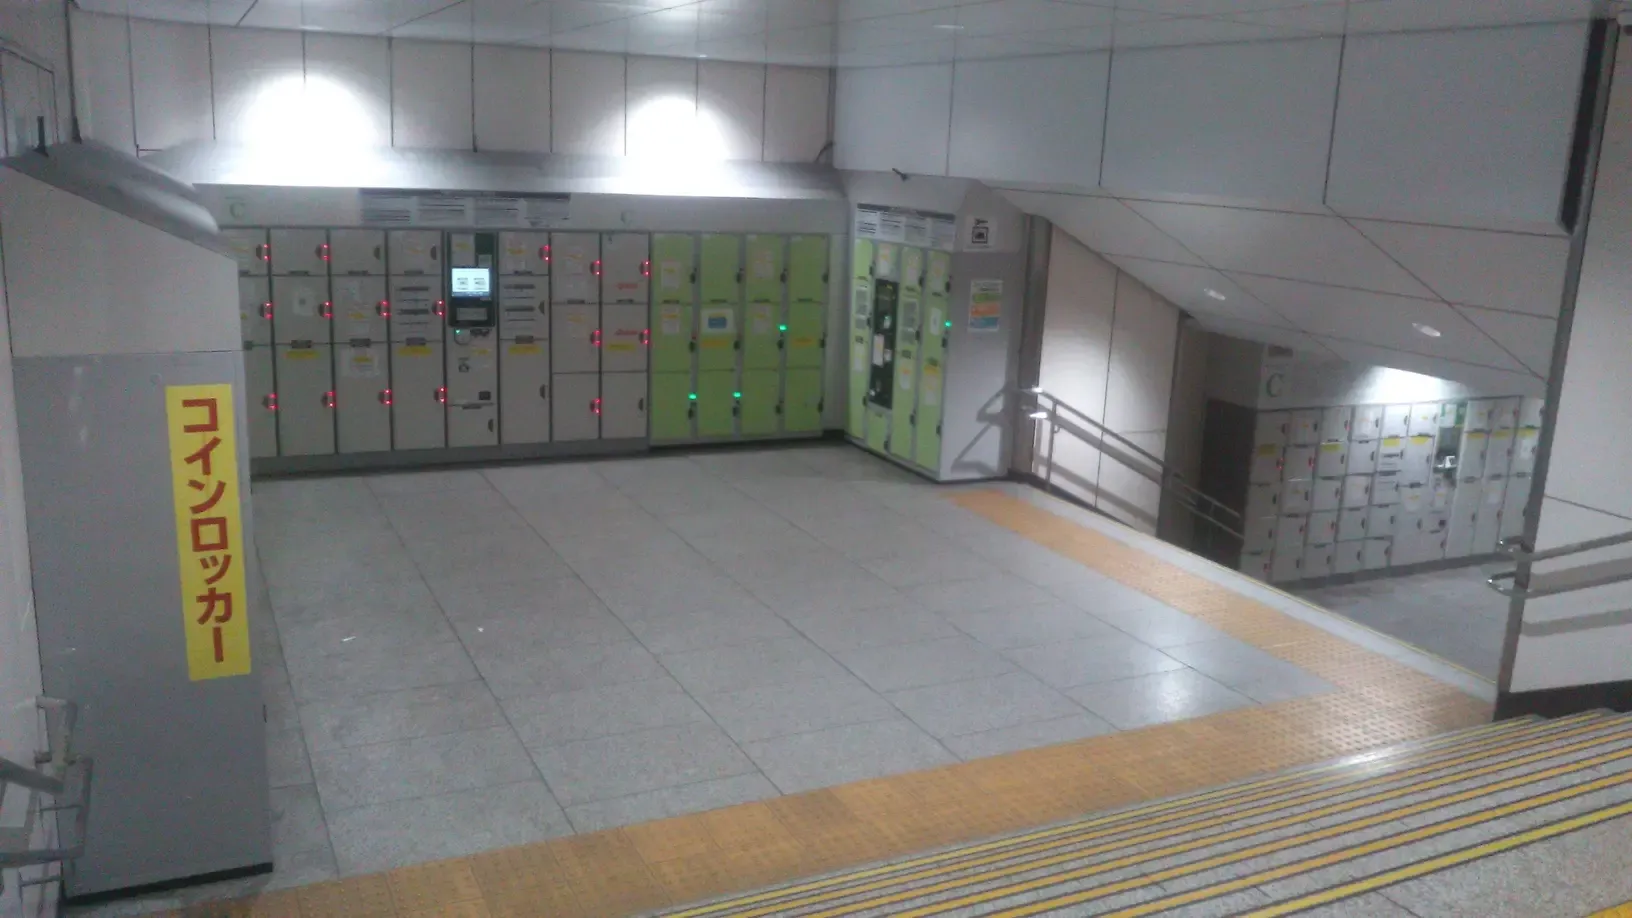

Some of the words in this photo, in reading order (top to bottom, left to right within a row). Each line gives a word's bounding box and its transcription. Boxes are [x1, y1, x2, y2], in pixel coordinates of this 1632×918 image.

[1266, 372, 1286, 398] C
[182, 397, 232, 663] コインロッカー
